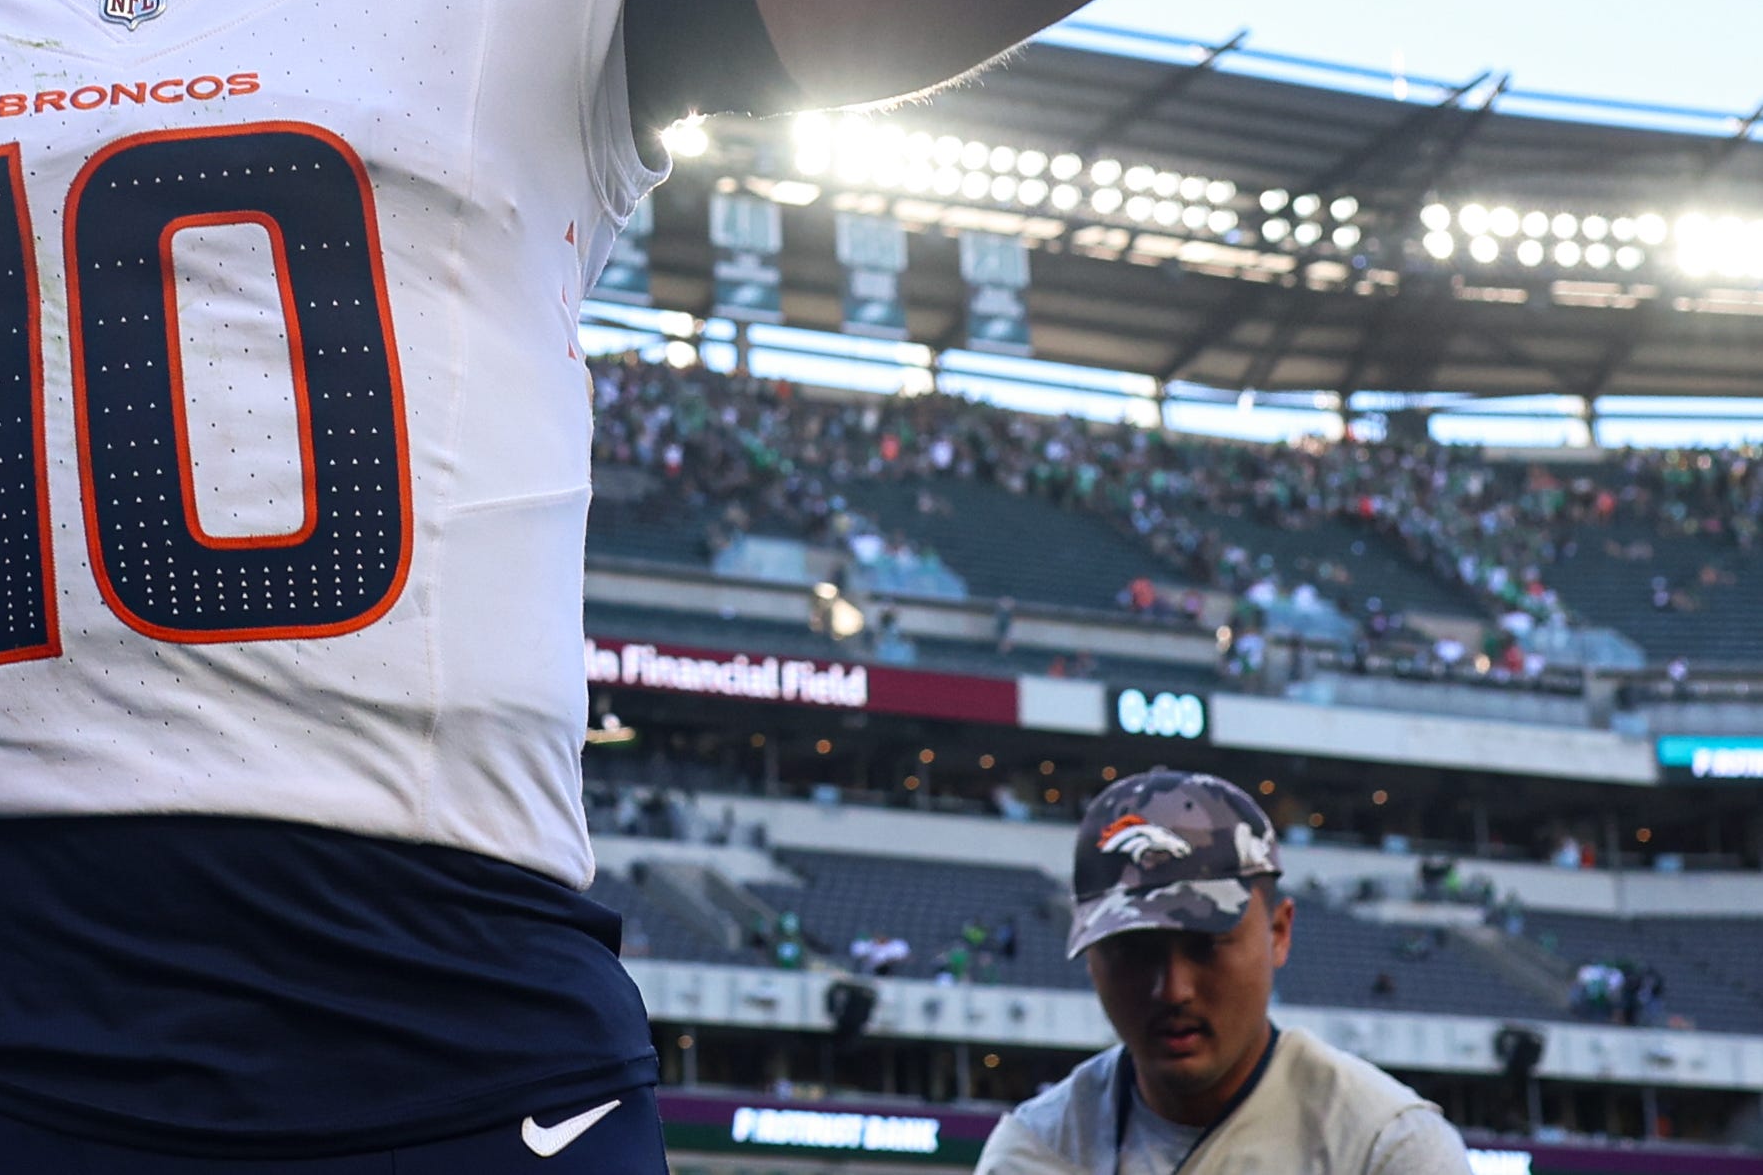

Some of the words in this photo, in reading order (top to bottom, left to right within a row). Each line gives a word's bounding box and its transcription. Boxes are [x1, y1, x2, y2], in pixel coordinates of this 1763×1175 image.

[622, 643, 781, 700] Financial
[782, 660, 867, 707] Field
[862, 1114, 940, 1153] BANK
